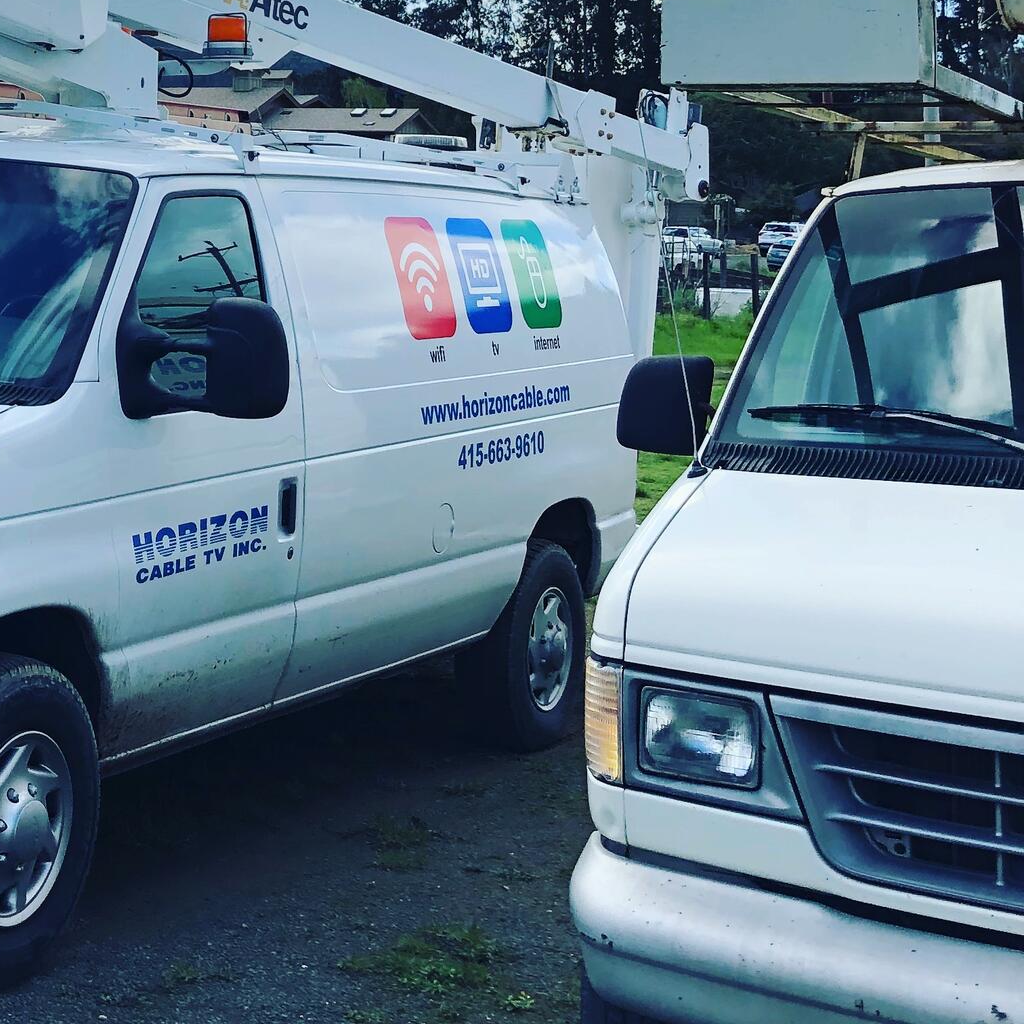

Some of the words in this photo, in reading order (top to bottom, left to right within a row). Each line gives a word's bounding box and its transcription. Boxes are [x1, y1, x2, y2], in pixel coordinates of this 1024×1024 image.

[470, 257, 490, 279] HD
[429, 345, 447, 363] wifi
[491, 340, 500, 356] tv
[533, 335, 561, 351] internet
[421, 384, 571, 425] www.horizoncable.com
[458, 430, 545, 470] 415-663-9610
[131, 505, 269, 564] HORIZON
[135, 554, 196, 584] CABLE
[203, 546, 226, 565] TV
[232, 538, 267, 558] INC.
